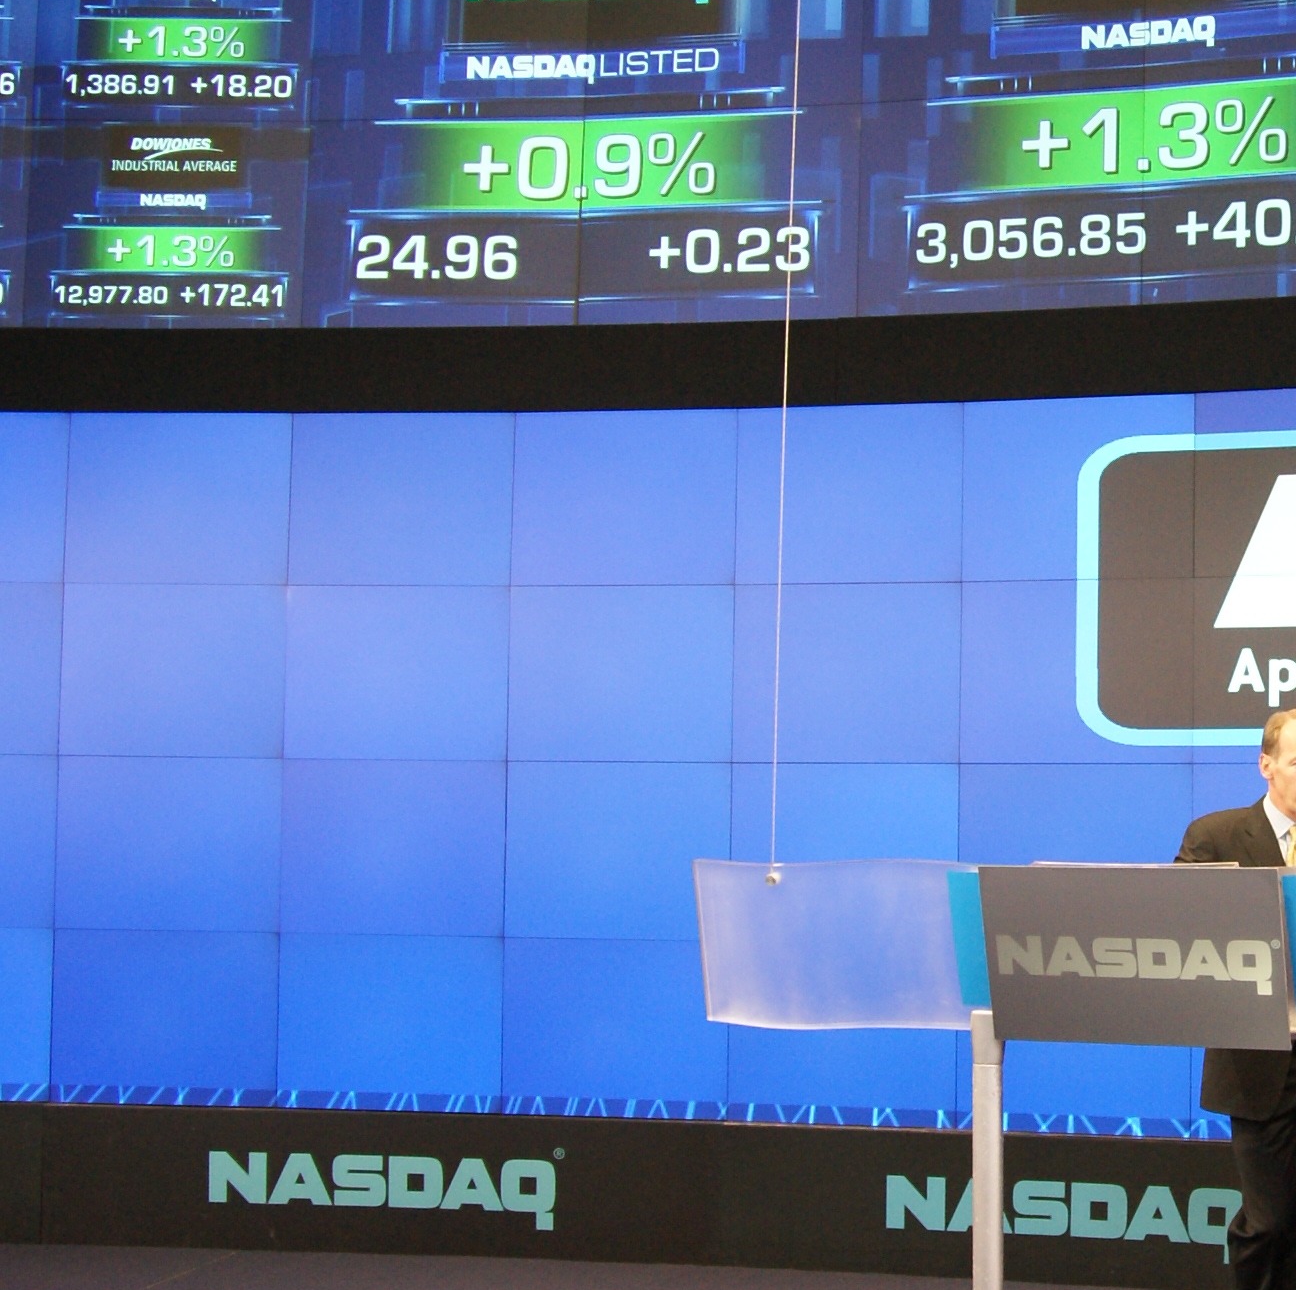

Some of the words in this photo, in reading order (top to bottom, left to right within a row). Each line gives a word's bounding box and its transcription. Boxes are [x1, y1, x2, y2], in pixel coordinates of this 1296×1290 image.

[118, 25, 245, 59] +1.3%
[1081, 15, 1215, 49] NASDAQ
[66, 73, 175, 98] 1,386.91
[191, 73, 293, 99] +18.20
[1022, 95, 1288, 175] +1.3%
[112, 159, 180, 173] INDUSTRIAL
[183, 159, 237, 173] AVERAGE
[464, 131, 716, 200] +0.9%
[140, 193, 206, 210] NASDAQ
[108, 235, 235, 268] +1.3%
[356, 234, 519, 280] 24.96
[649, 227, 812, 274] +0.23
[916, 212, 1147, 268] 3,056.85
[54, 286, 168, 307] 12,977.80
[180, 284, 285, 307] +172.41
[996, 934, 1273, 996] NASDAQ
[208, 1150, 556, 1231] NASDAQ
